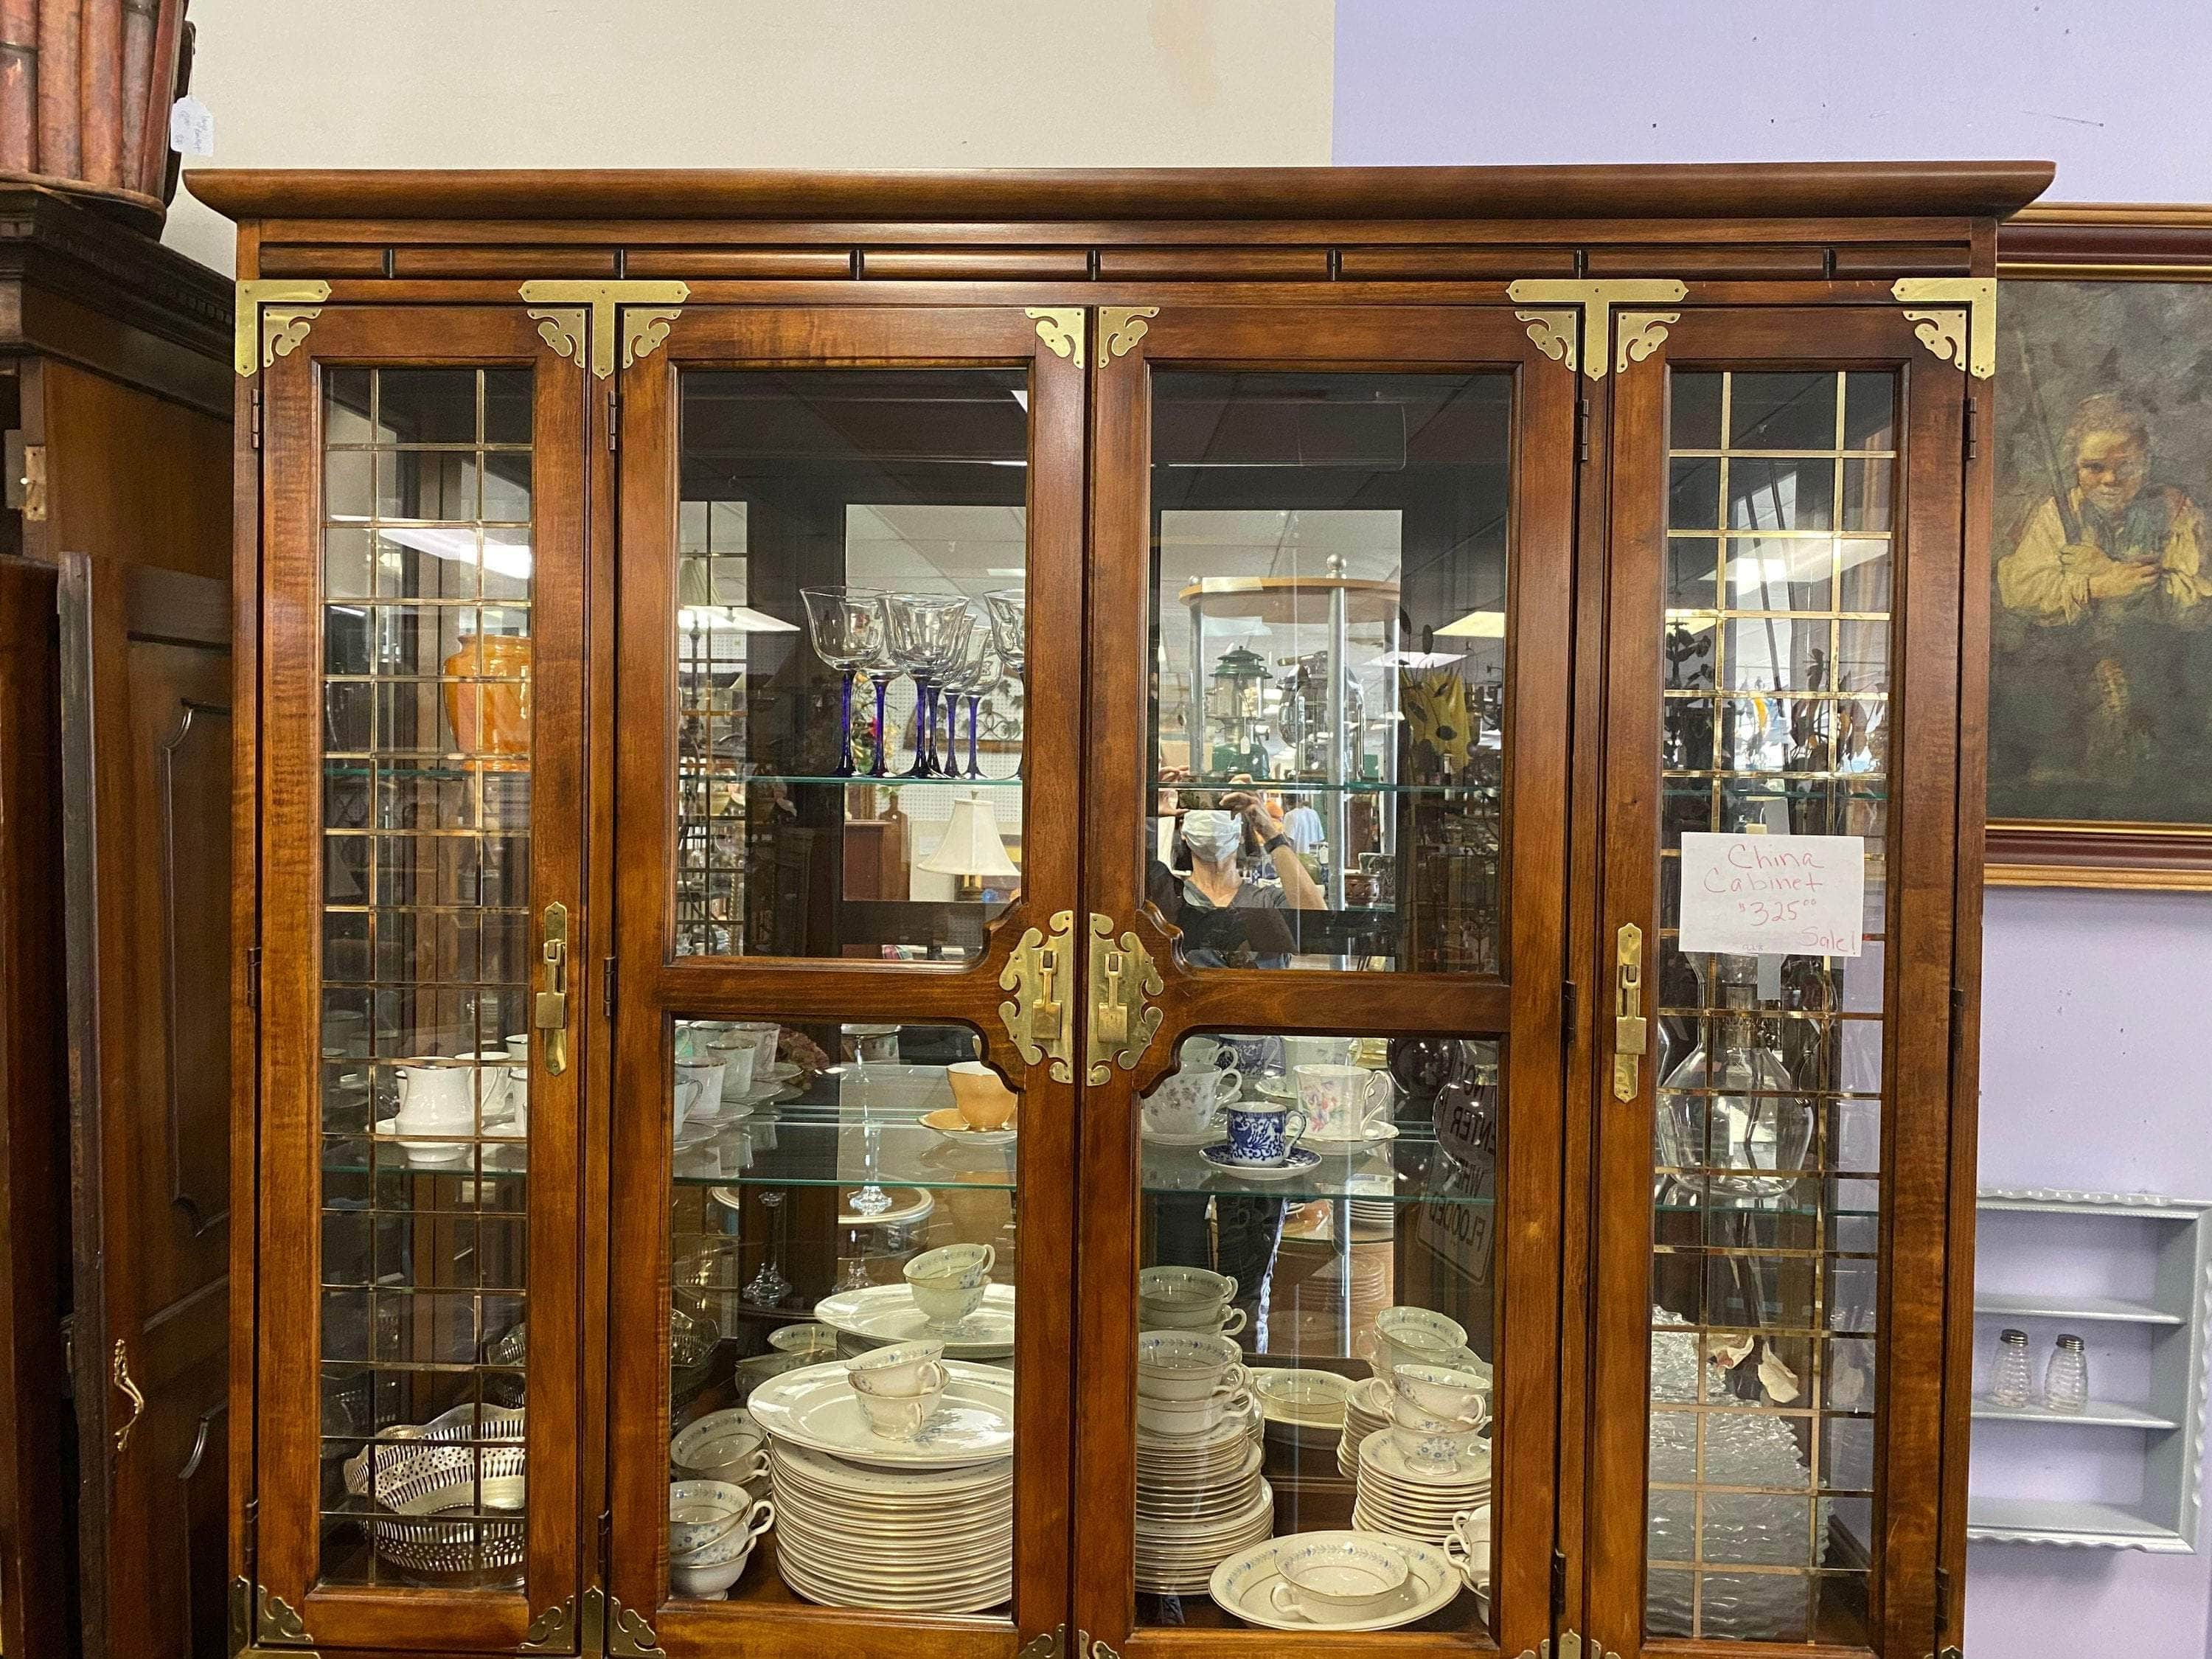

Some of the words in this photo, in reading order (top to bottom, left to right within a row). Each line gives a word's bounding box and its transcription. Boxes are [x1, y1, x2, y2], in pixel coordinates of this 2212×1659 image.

[1728, 844, 1824, 869] China
[1704, 868, 1823, 893] Cabinet
[1800, 927, 1856, 955] Sale!
